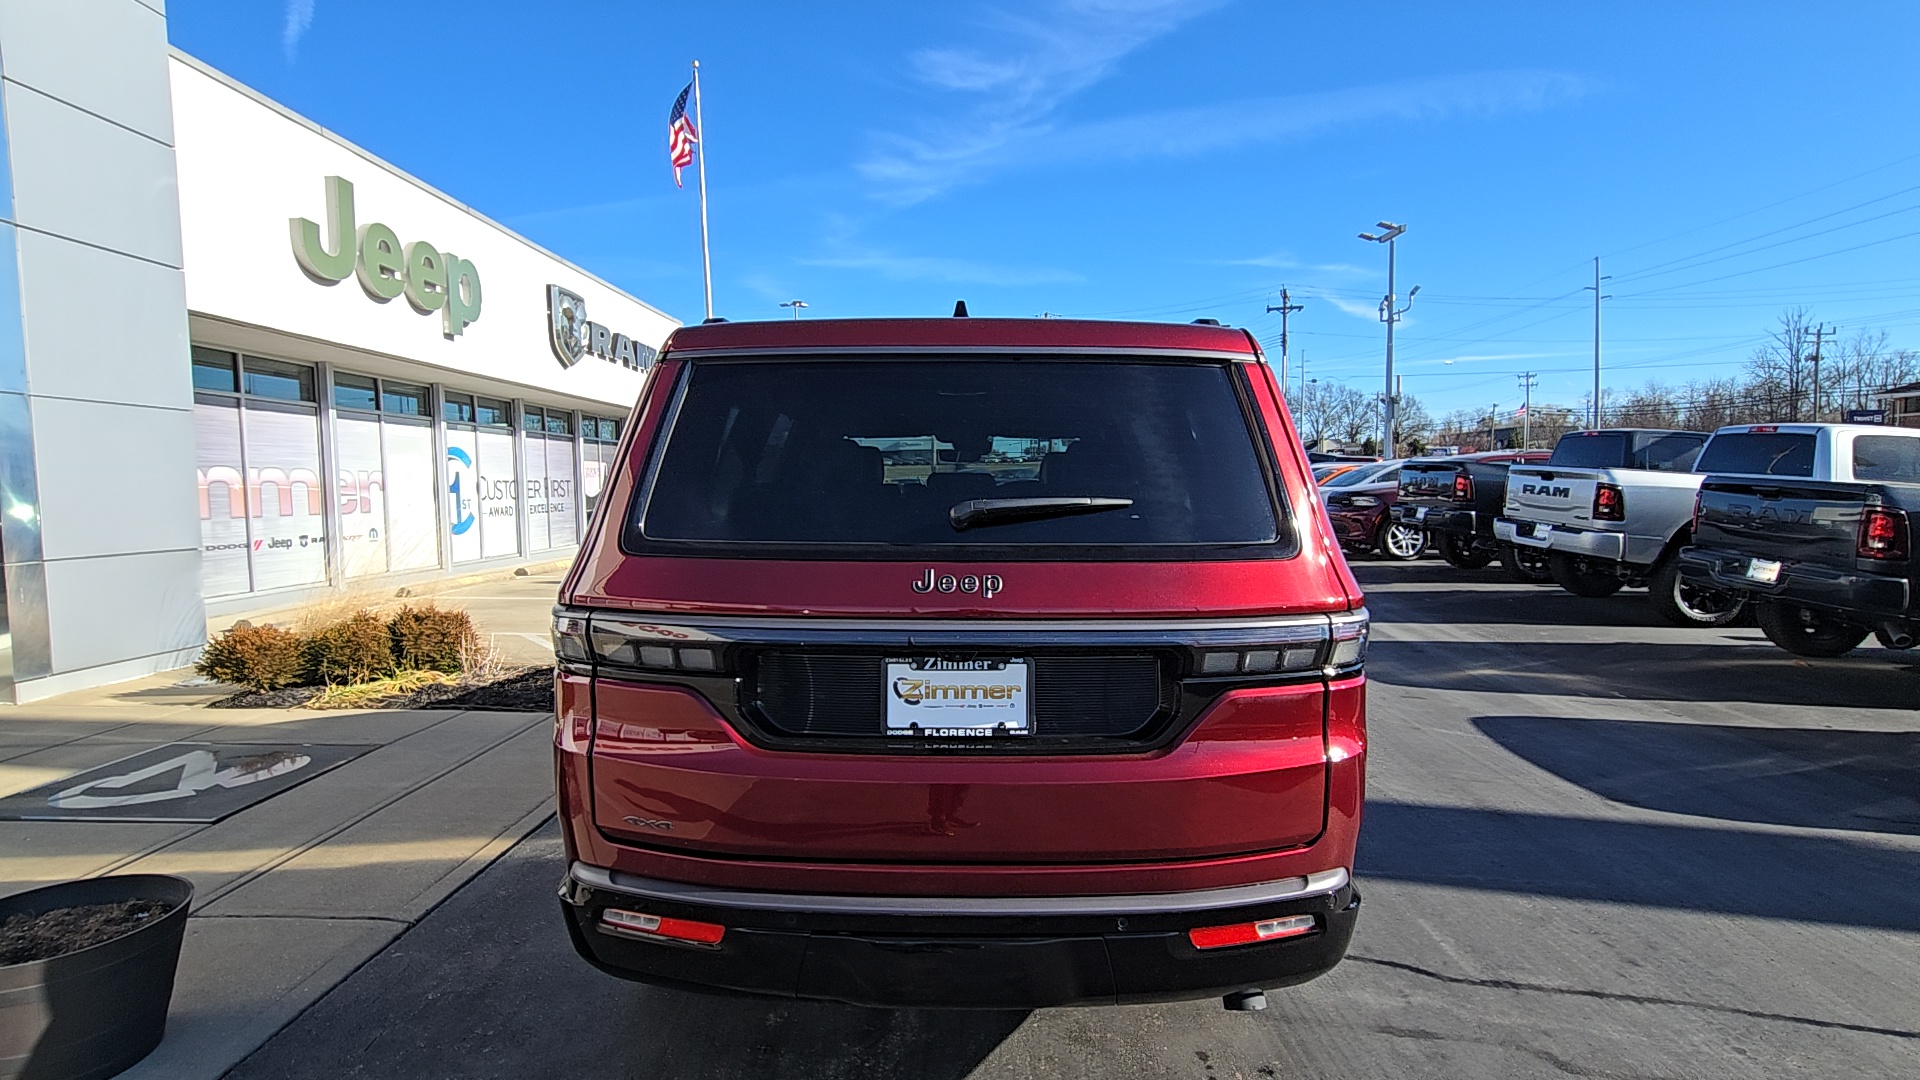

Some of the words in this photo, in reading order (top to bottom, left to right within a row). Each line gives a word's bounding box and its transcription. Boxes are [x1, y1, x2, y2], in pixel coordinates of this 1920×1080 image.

[289, 176, 482, 340] Jeep
[586, 321, 658, 374] RAM
[476, 475, 542, 501] CUSTOER
[1522, 483, 1571, 499] RAM
[488, 505, 514, 518] AWARD
[529, 502, 565, 515] EXCELENCE
[1727, 502, 1813, 525] RAM
[205, 543, 249, 551] DODG
[267, 537, 293, 550] Jeep
[310, 536, 326, 544] RA
[912, 568, 1004, 599] Jeep
[923, 656, 992, 670] Zimmer
[1009, 656, 1024, 664] Jeep
[901, 679, 1022, 700] Zimmer
[924, 728, 993, 737] FLORENCE
